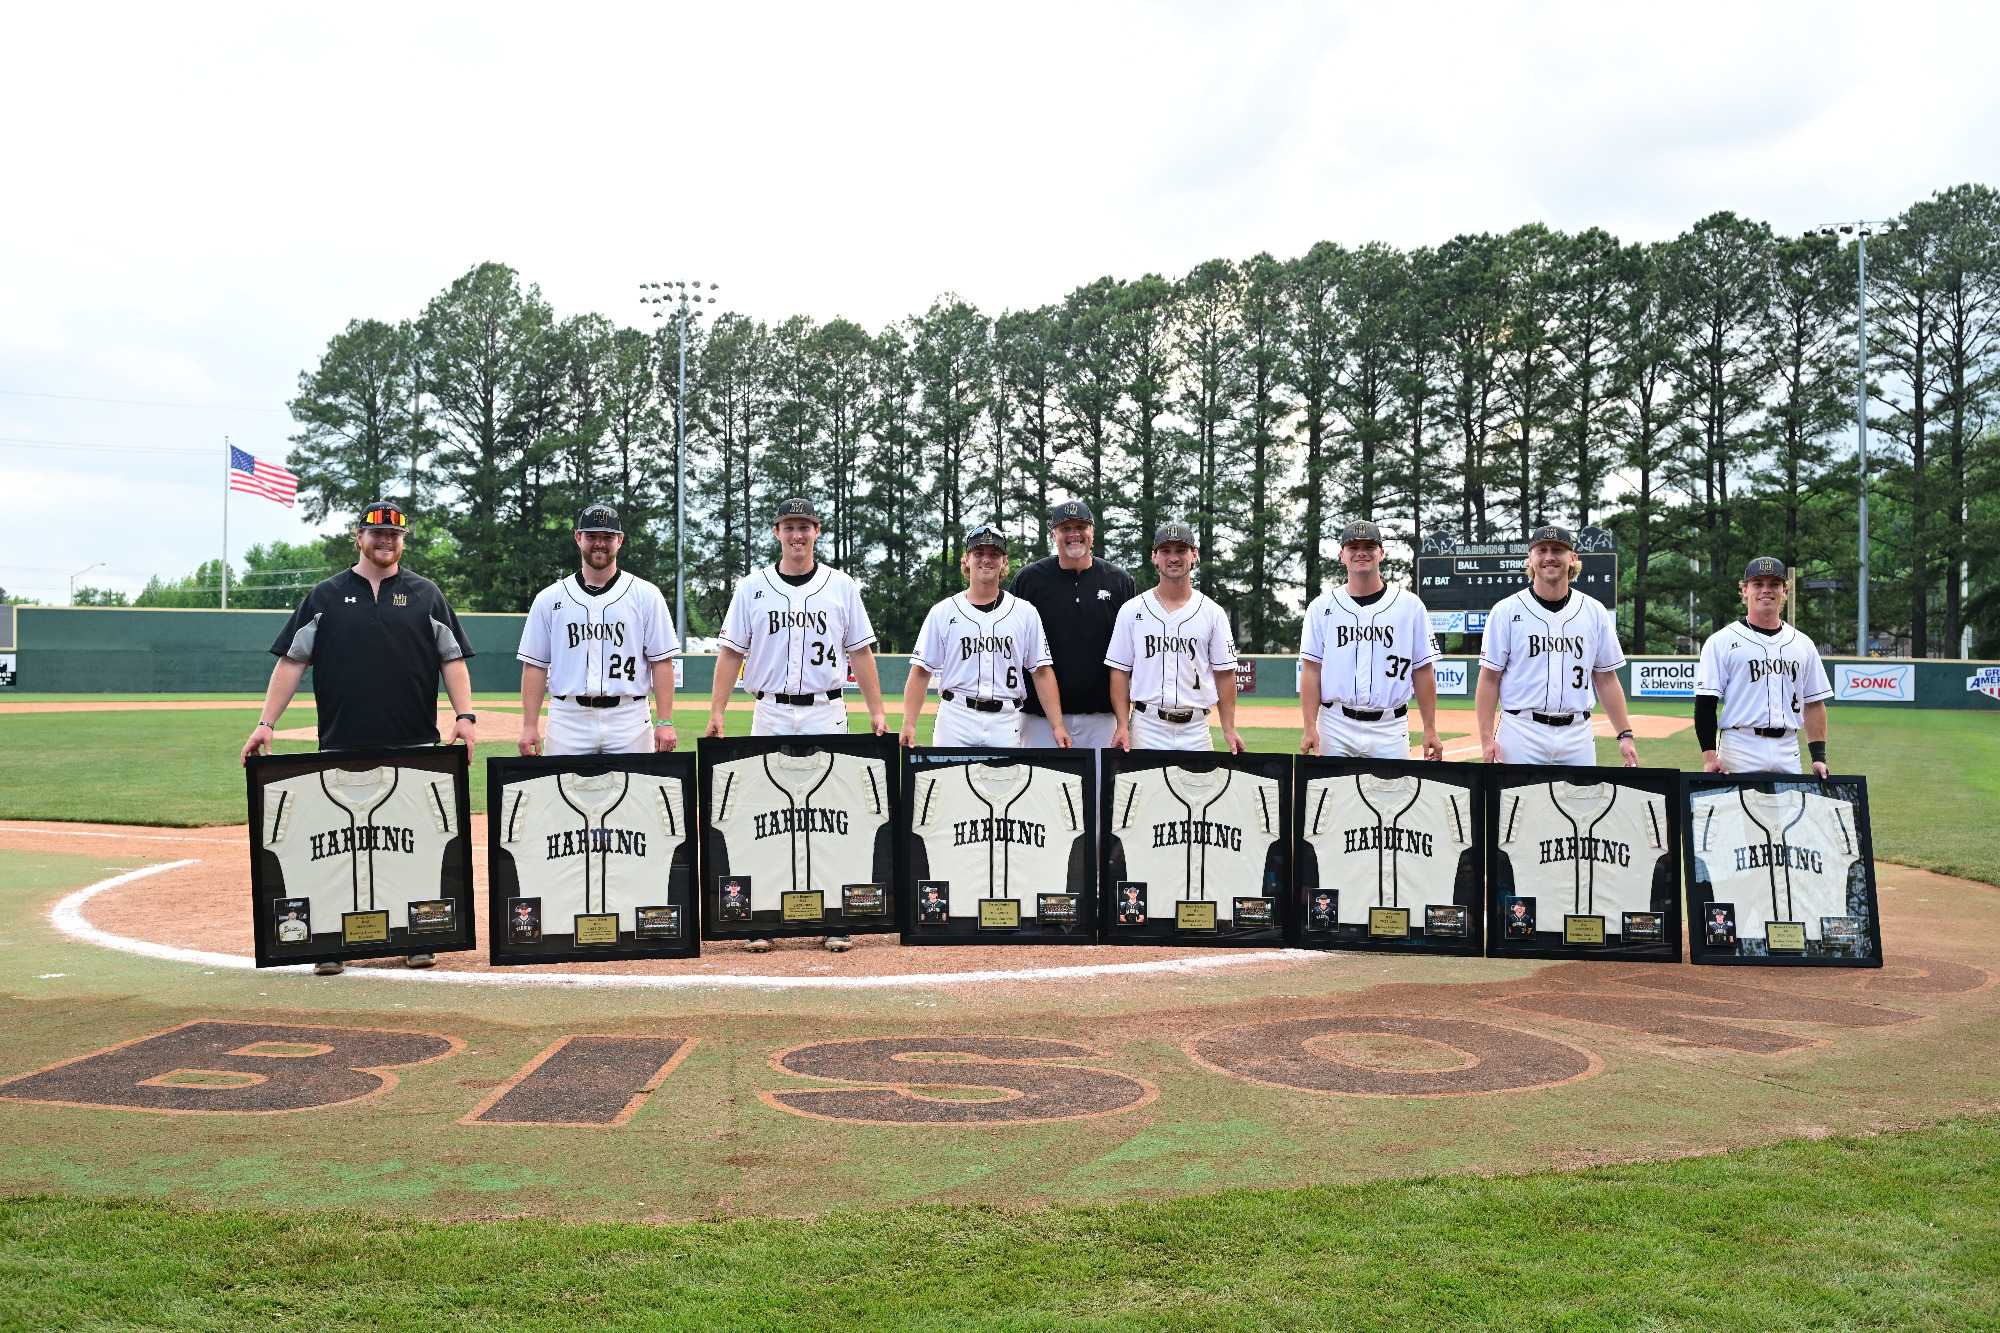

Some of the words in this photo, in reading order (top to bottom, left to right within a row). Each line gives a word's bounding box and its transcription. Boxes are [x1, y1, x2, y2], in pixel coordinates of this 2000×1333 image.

[1455, 544, 1506, 555] HARDING
[1457, 561, 1479, 570] BALL
[1422, 577, 1432, 586] AT
[1434, 576, 1450, 586] BAT
[1467, 577, 1473, 585] 1
[1477, 577, 1483, 585] 2
[1487, 577, 1493, 585] 3
[1507, 576, 1513, 584] 5
[1517, 576, 1523, 584] 6
[1587, 574, 1595, 582] H
[1604, 574, 1611, 582] E
[567, 621, 626, 649] BISONS
[768, 610, 828, 636] BISONS
[960, 635, 1014, 661] BISONS
[1144, 634, 1198, 661] BISONS
[1336, 625, 1395, 649] BISONS
[1528, 634, 1585, 660] BISONS
[608, 653, 636, 682] 24
[810, 641, 837, 668] 34
[1385, 654, 1411, 681] 37
[1005, 666, 1018, 690] 6
[1640, 663, 1695, 678] arnold
[1640, 679, 1649, 689] &
[1652, 678, 1694, 690] blevins
[1748, 658, 1800, 683] BISONS
[1850, 677, 1898, 689] SONIC
[754, 807, 849, 840] HARDING
[953, 817, 1046, 849] HARDING
[1152, 820, 1242, 852] HARDING
[309, 825, 415, 862] HARDING
[546, 828, 647, 860] HARDING
[1343, 825, 1433, 857] HARDING
[1539, 836, 1631, 868] HARDING
[1734, 843, 1823, 875] HARDING
